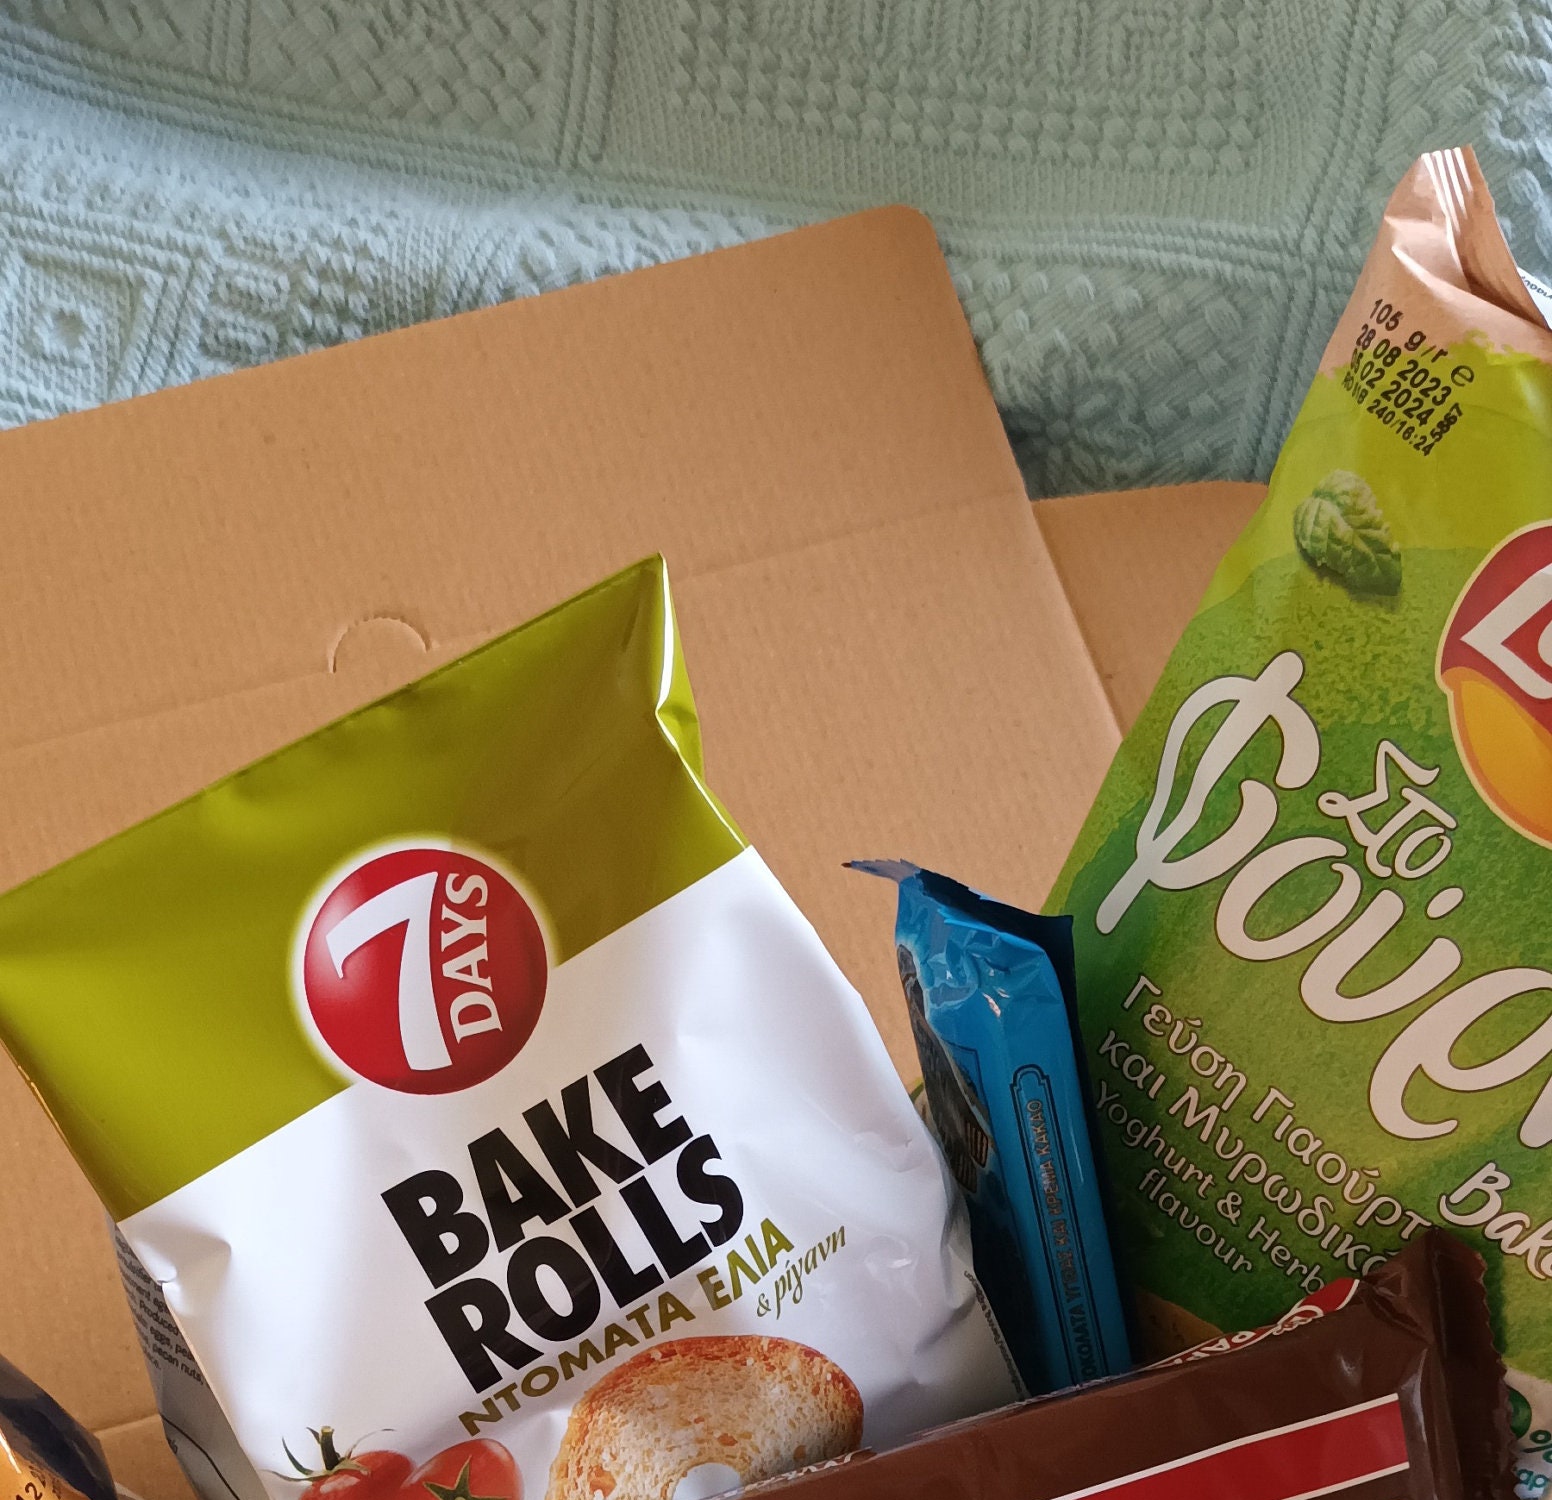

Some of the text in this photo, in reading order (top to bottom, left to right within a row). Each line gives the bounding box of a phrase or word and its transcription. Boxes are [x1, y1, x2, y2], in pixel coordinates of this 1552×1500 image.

[1355, 323, 1377, 351] 28
[1373, 338, 1401, 368] 08
[1396, 359, 1452, 407] 2023
[1369, 298, 1403, 331] 105
[1360, 361, 1386, 390] 02
[1380, 380, 1435, 428] 2024
[325, 870, 503, 1072] 7 DAYS
[1096, 650, 1552, 1148] Φούρ
[1026, 1099, 1049, 1156] ΚΑΚΑΟ
[1097, 1029, 1167, 1101] και
[1121, 974, 1432, 1241] Γεύση Γιαούρτ
[380, 1043, 695, 1290] BAKE
[1095, 1079, 1326, 1296] Yoghurt & Herb
[1138, 1167, 1254, 1277] flavour
[423, 1133, 745, 1395] ROLLS
[458, 1216, 796, 1437] ΝΤΟΜΑΤΑ ΕΛΙΑ
[755, 1293, 773, 1319] &
